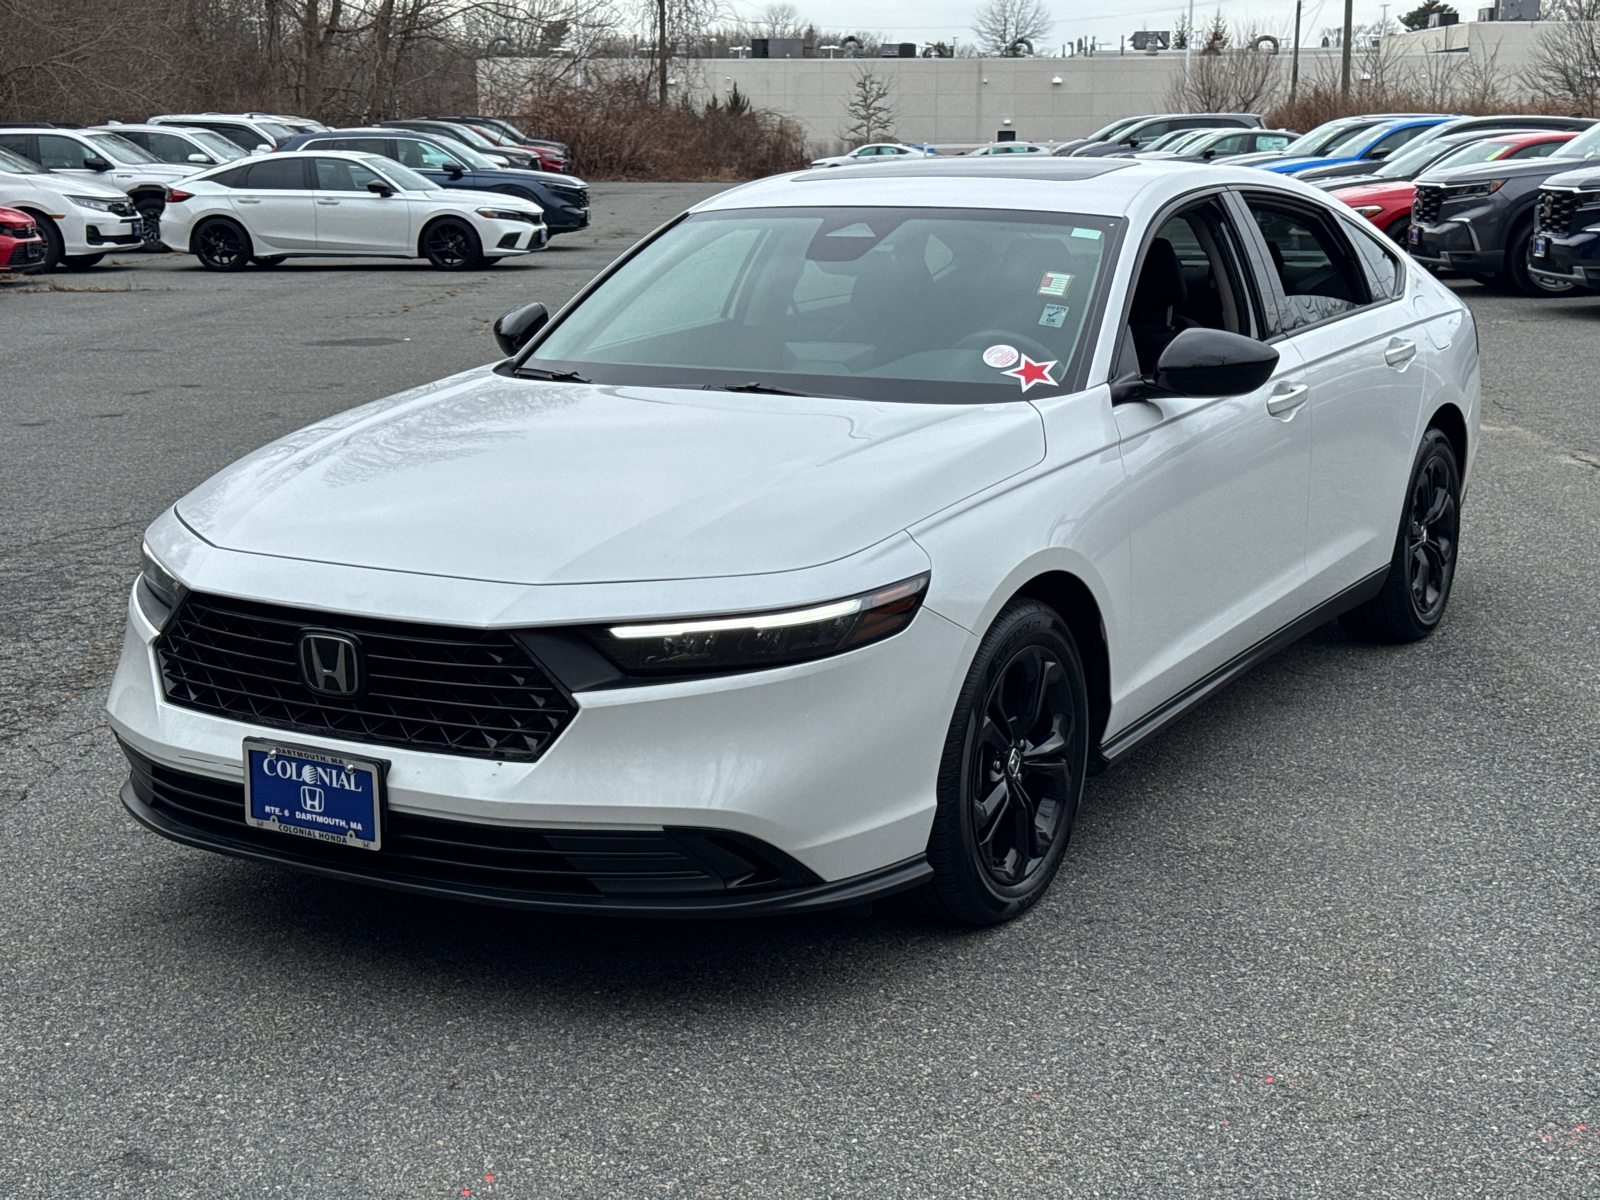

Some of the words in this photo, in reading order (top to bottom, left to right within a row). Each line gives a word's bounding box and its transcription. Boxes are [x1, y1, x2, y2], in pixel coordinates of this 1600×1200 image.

[331, 757, 344, 766] MA
[263, 757, 363, 792] COLONIAL
[284, 809, 290, 817] 6
[295, 811, 349, 829] DARTMOUTH,
[350, 821, 363, 831] MA
[278, 824, 317, 839] COLONIAL
[318, 832, 348, 844] HONDA
